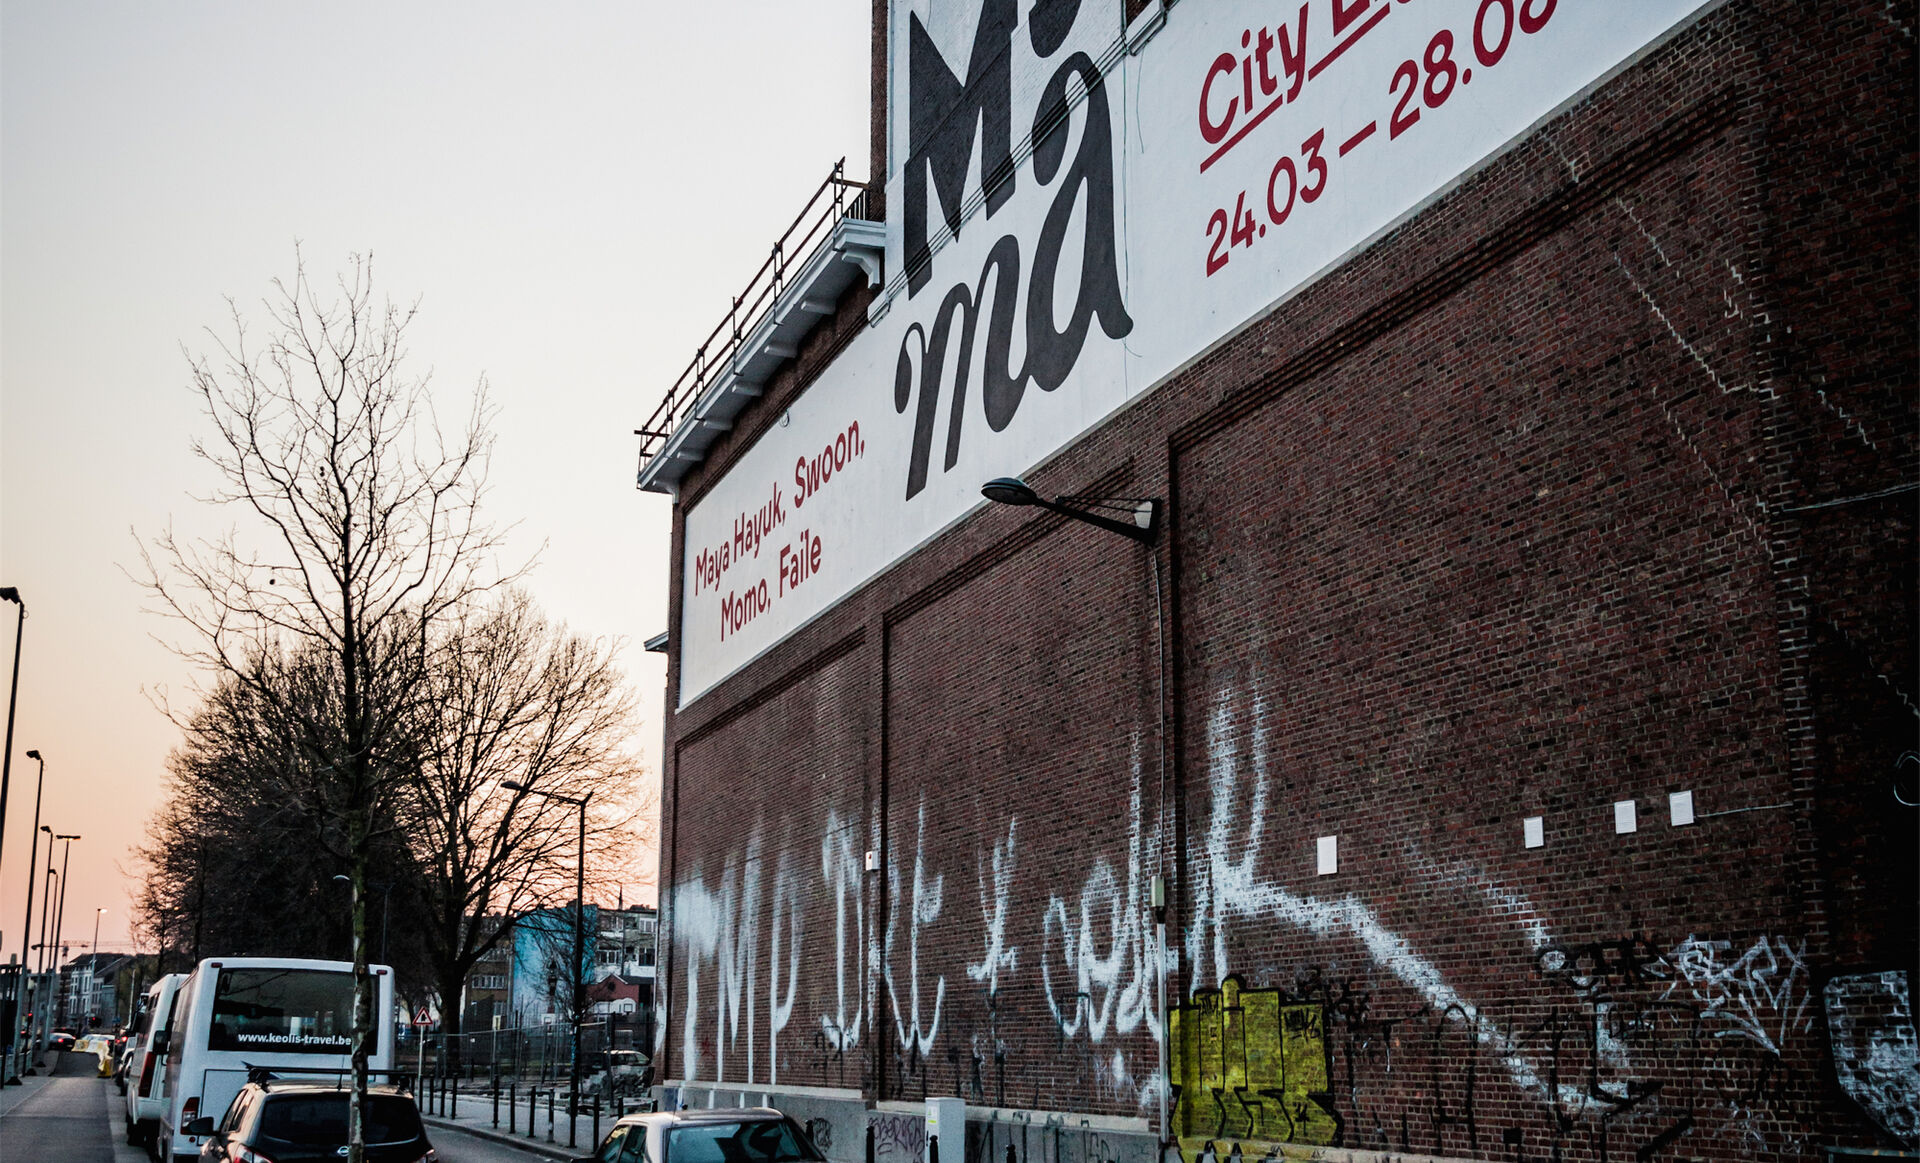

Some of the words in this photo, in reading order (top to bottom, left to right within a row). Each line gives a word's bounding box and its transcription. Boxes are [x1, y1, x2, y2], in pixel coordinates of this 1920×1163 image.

[1199, 3, 1310, 145] City
[904, 0, 1082, 300] M
[1205, 127, 1328, 277] 24.03
[895, 51, 1134, 501] ma
[695, 540, 730, 597] Maya
[733, 481, 786, 559] Hayuk,
[794, 420, 865, 509] Swoon,
[720, 578, 771, 642] Momo,
[779, 528, 822, 598] Faile
[238, 1033, 352, 1045] www.keolis-travel.be
